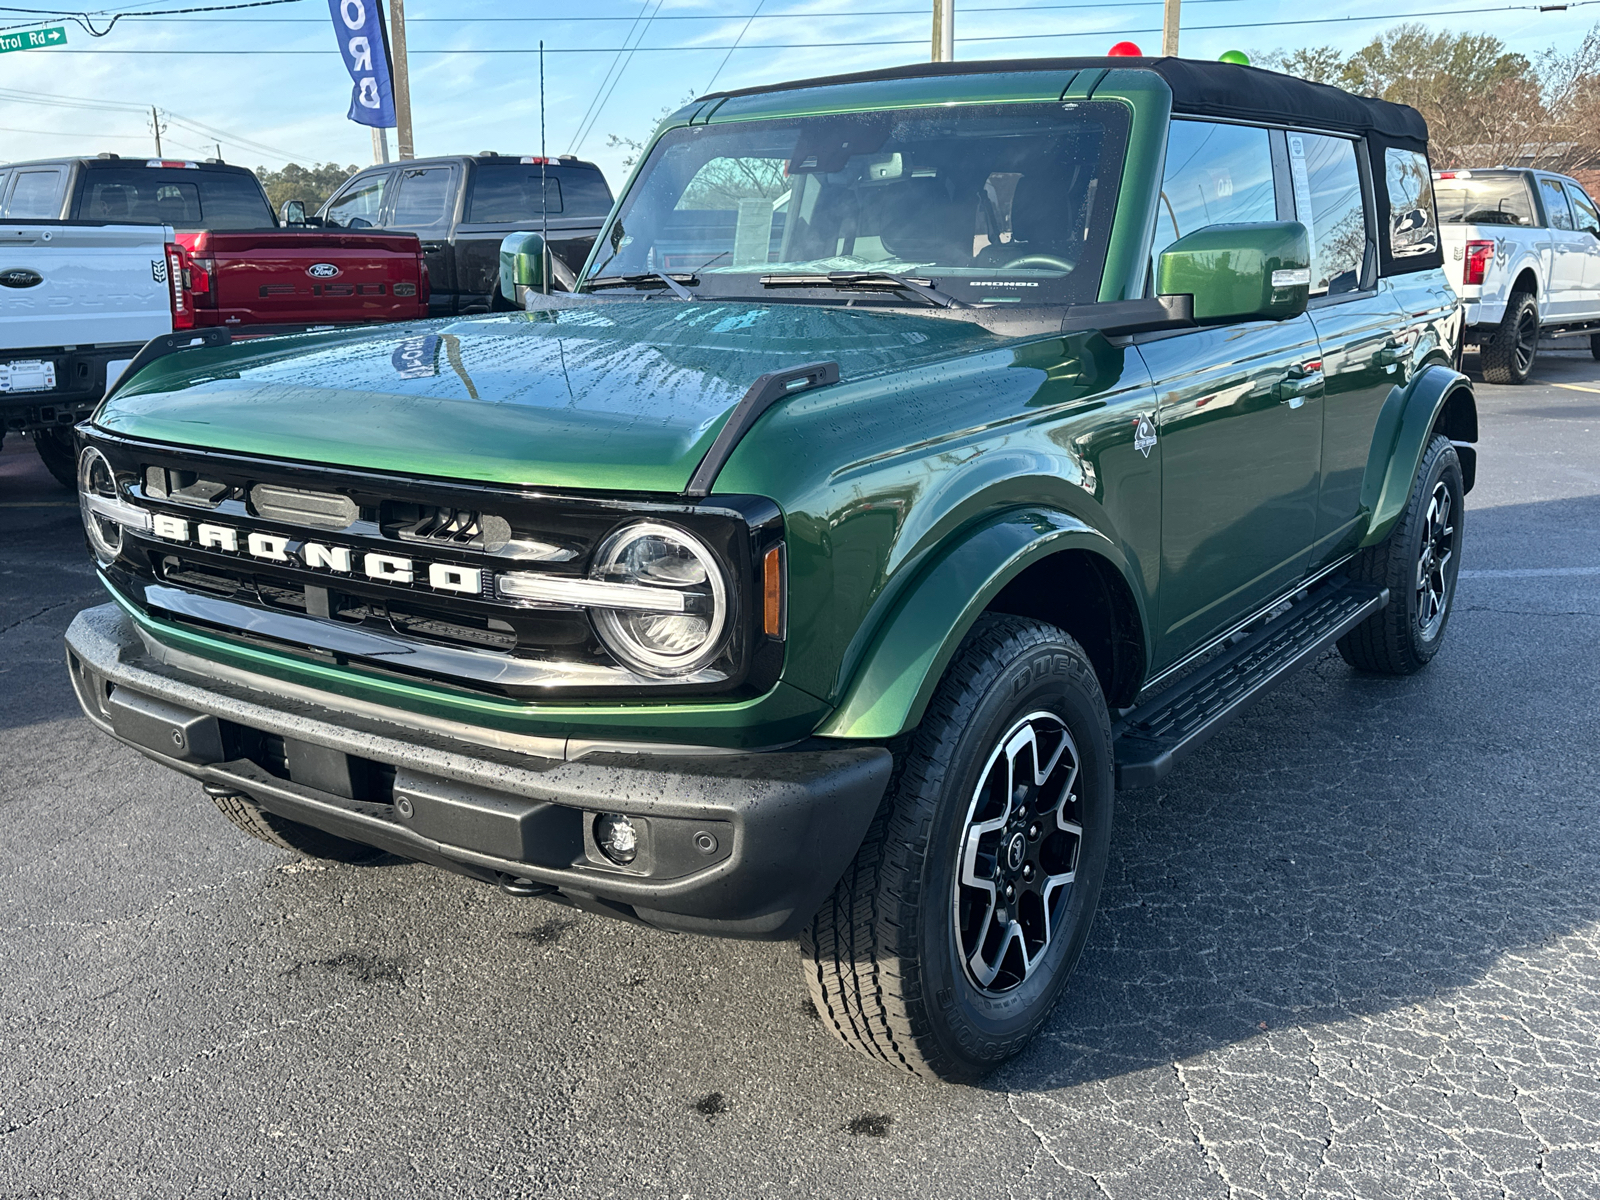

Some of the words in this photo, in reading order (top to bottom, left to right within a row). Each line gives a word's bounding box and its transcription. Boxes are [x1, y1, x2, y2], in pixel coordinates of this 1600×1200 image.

[28, 31, 46, 46] Rd
[8, 272, 34, 284] Ford
[313, 265, 334, 276] Ford
[258, 283, 387, 299] F-150
[48, 292, 154, 308] DUTY
[153, 513, 483, 595] BRONCO
[1011, 653, 1105, 720] DUELER
